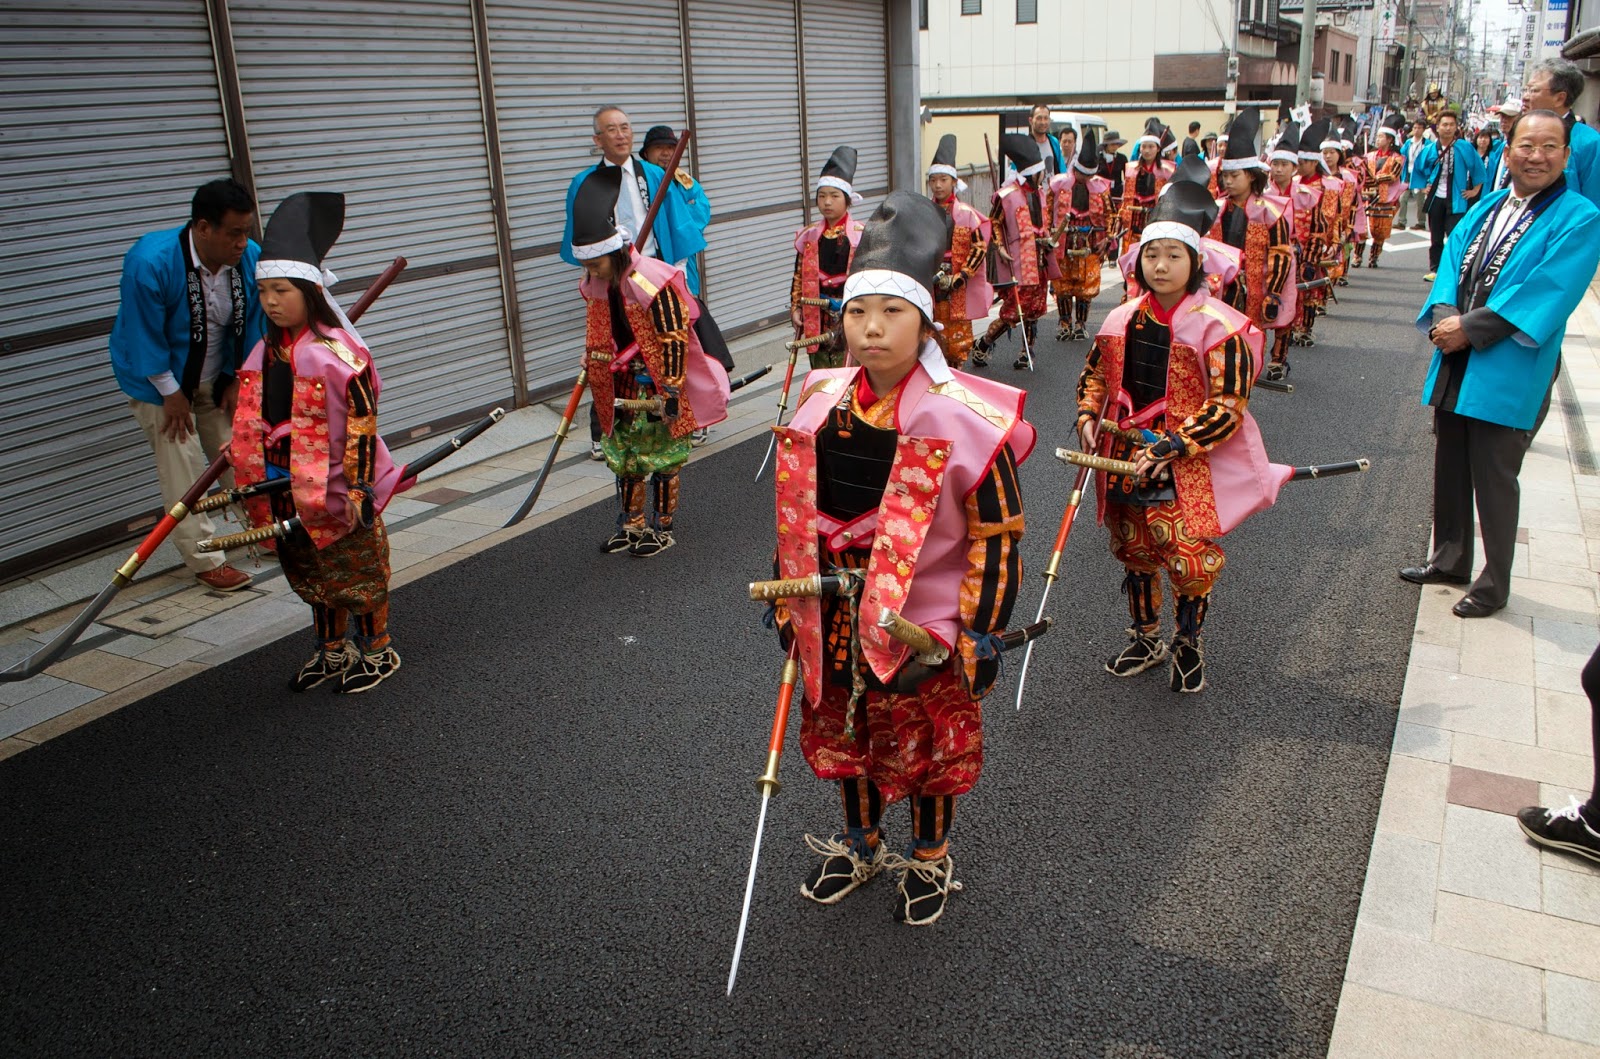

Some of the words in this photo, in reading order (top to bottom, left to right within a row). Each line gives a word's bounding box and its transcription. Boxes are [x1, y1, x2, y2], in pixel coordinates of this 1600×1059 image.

[1522, 14, 1536, 59] 塩田屋本店
[187, 271, 204, 343] 亀岡光秀まつり
